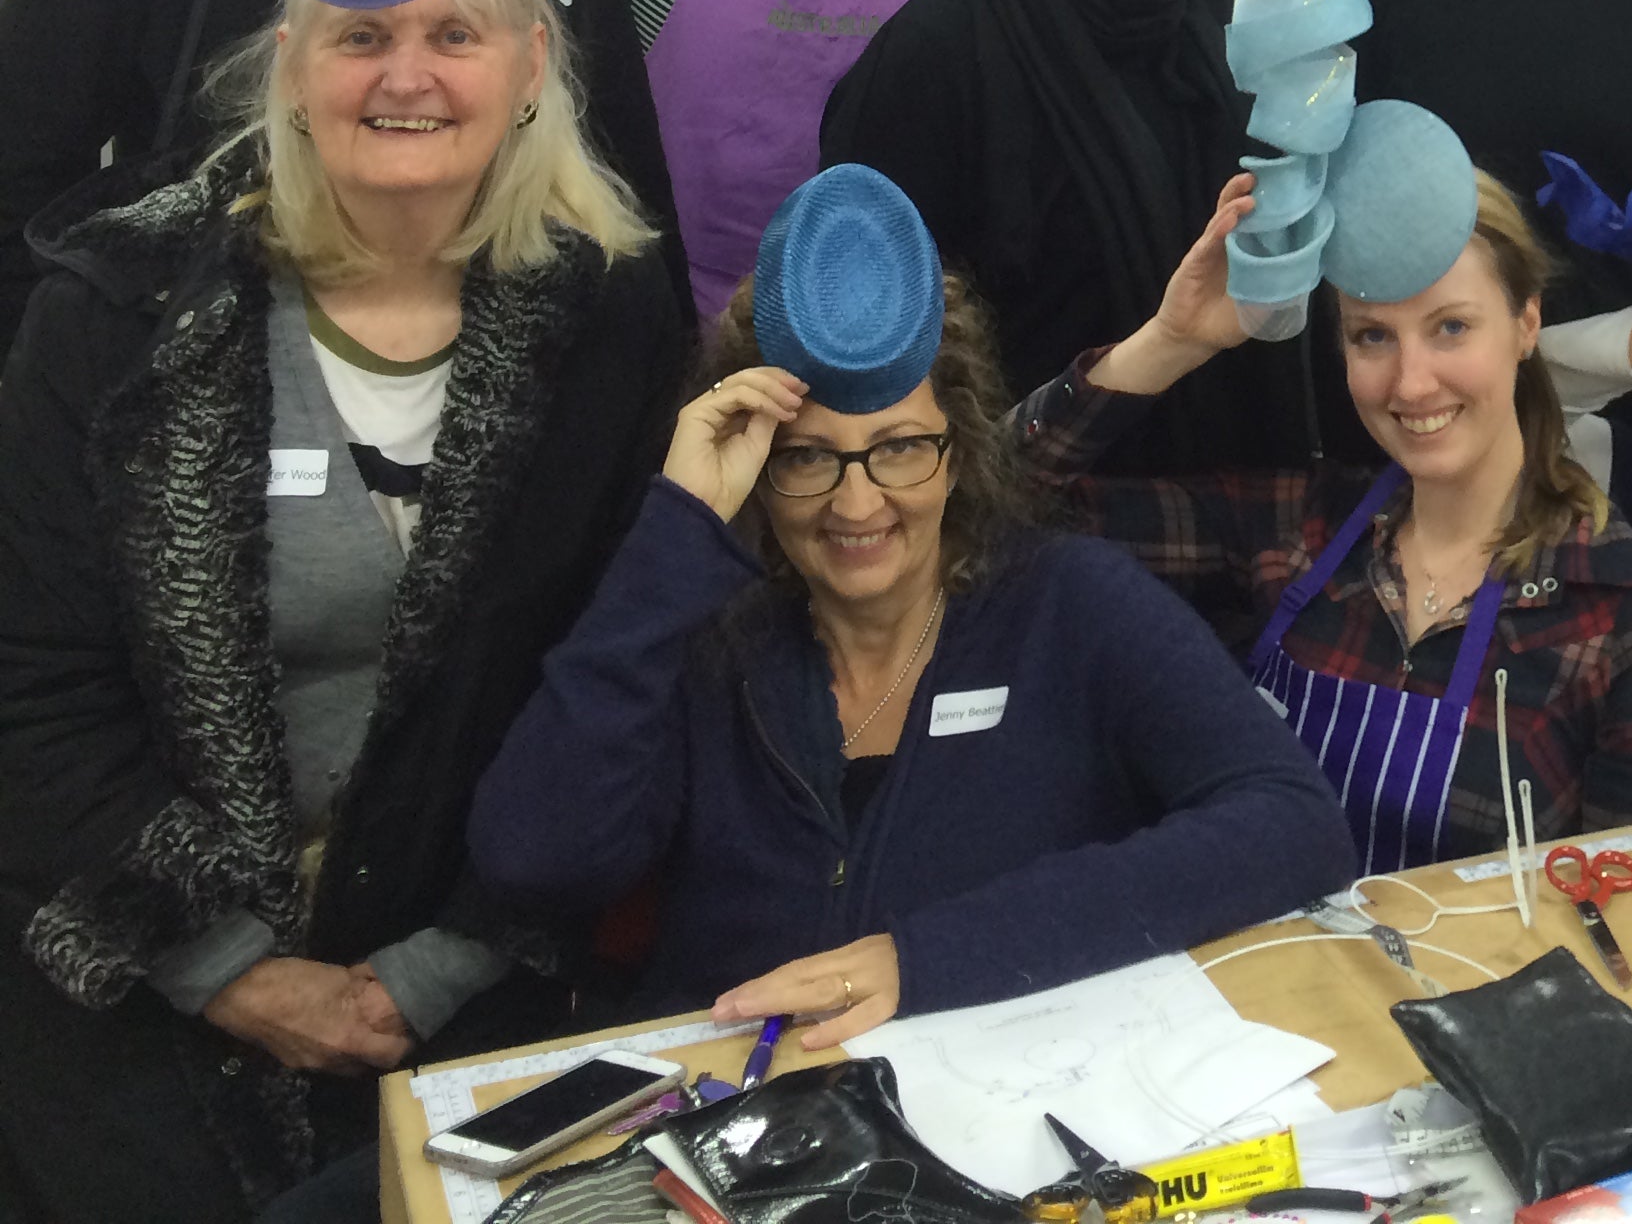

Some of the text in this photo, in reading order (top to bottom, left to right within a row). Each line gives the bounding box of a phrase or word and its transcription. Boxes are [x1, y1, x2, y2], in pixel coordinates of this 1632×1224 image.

[291, 469, 327, 481] Wood
[935, 710, 965, 723] Jenny
[1158, 1171, 1208, 1208] HU
